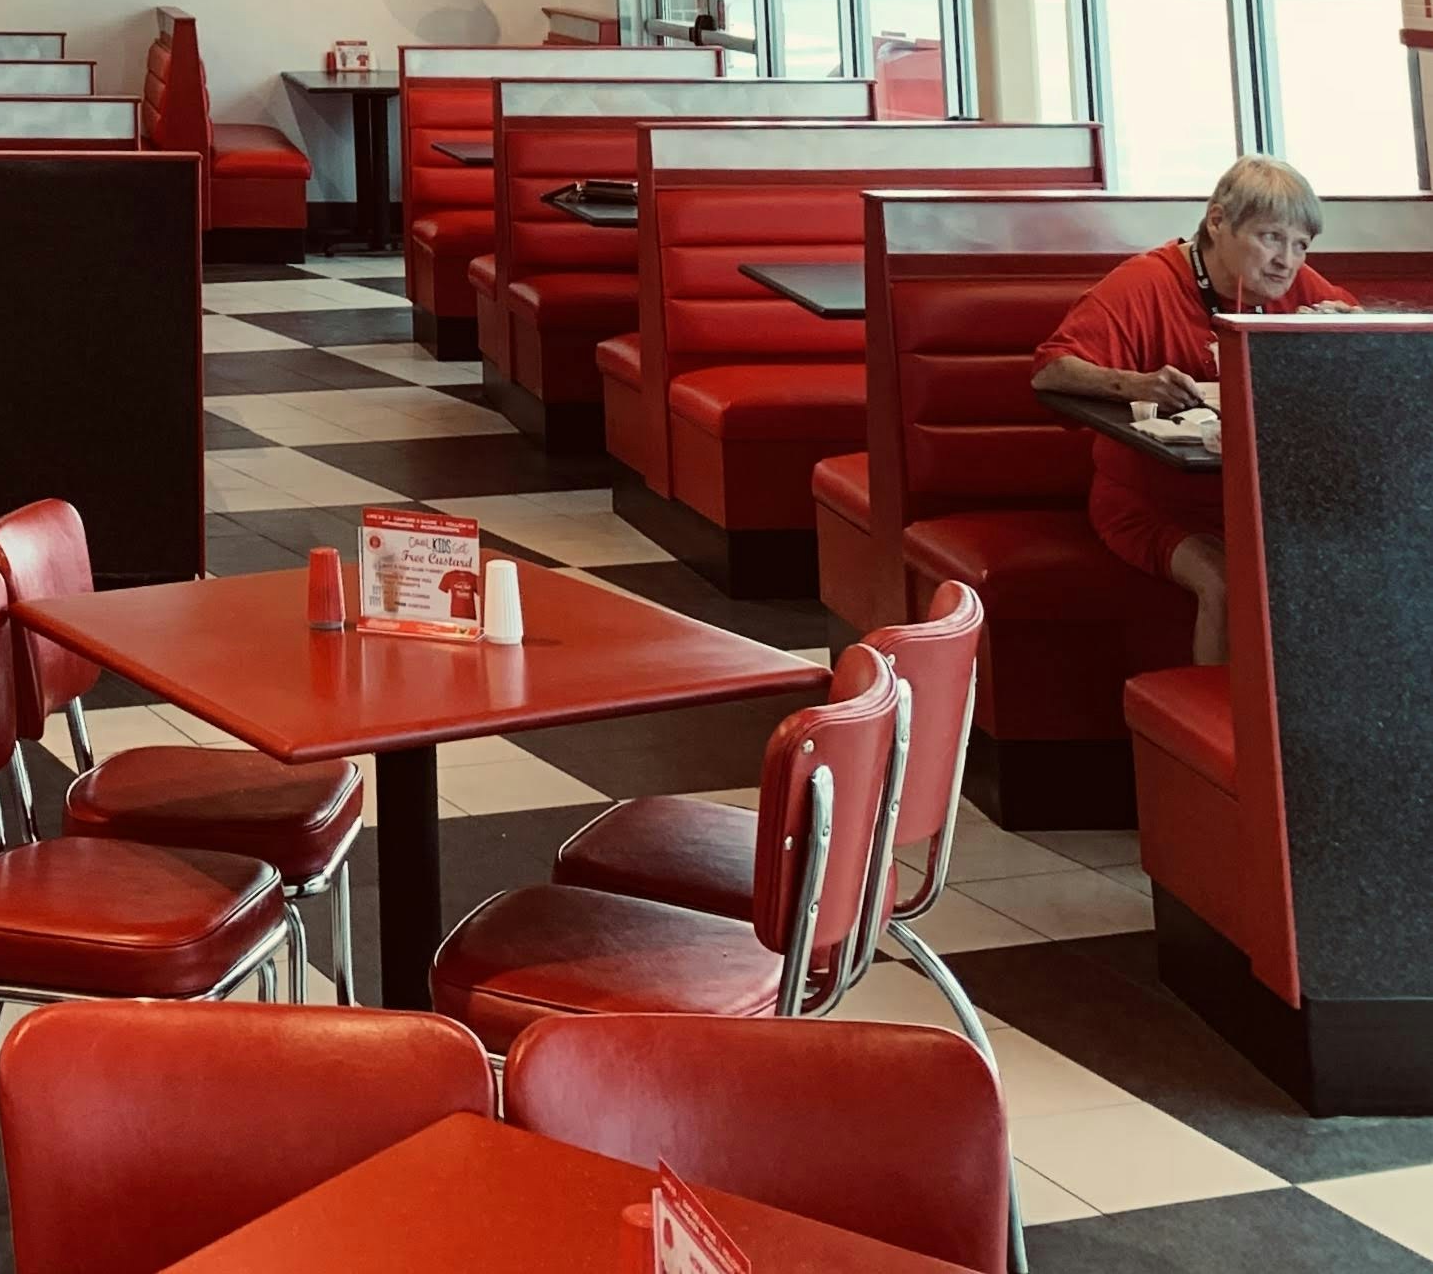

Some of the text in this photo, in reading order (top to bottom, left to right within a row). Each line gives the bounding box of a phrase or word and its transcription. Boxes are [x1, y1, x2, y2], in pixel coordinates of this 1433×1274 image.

[432, 537, 452, 554] KIDS
[401, 549, 425, 564] Free
[428, 553, 473, 569] Custard
